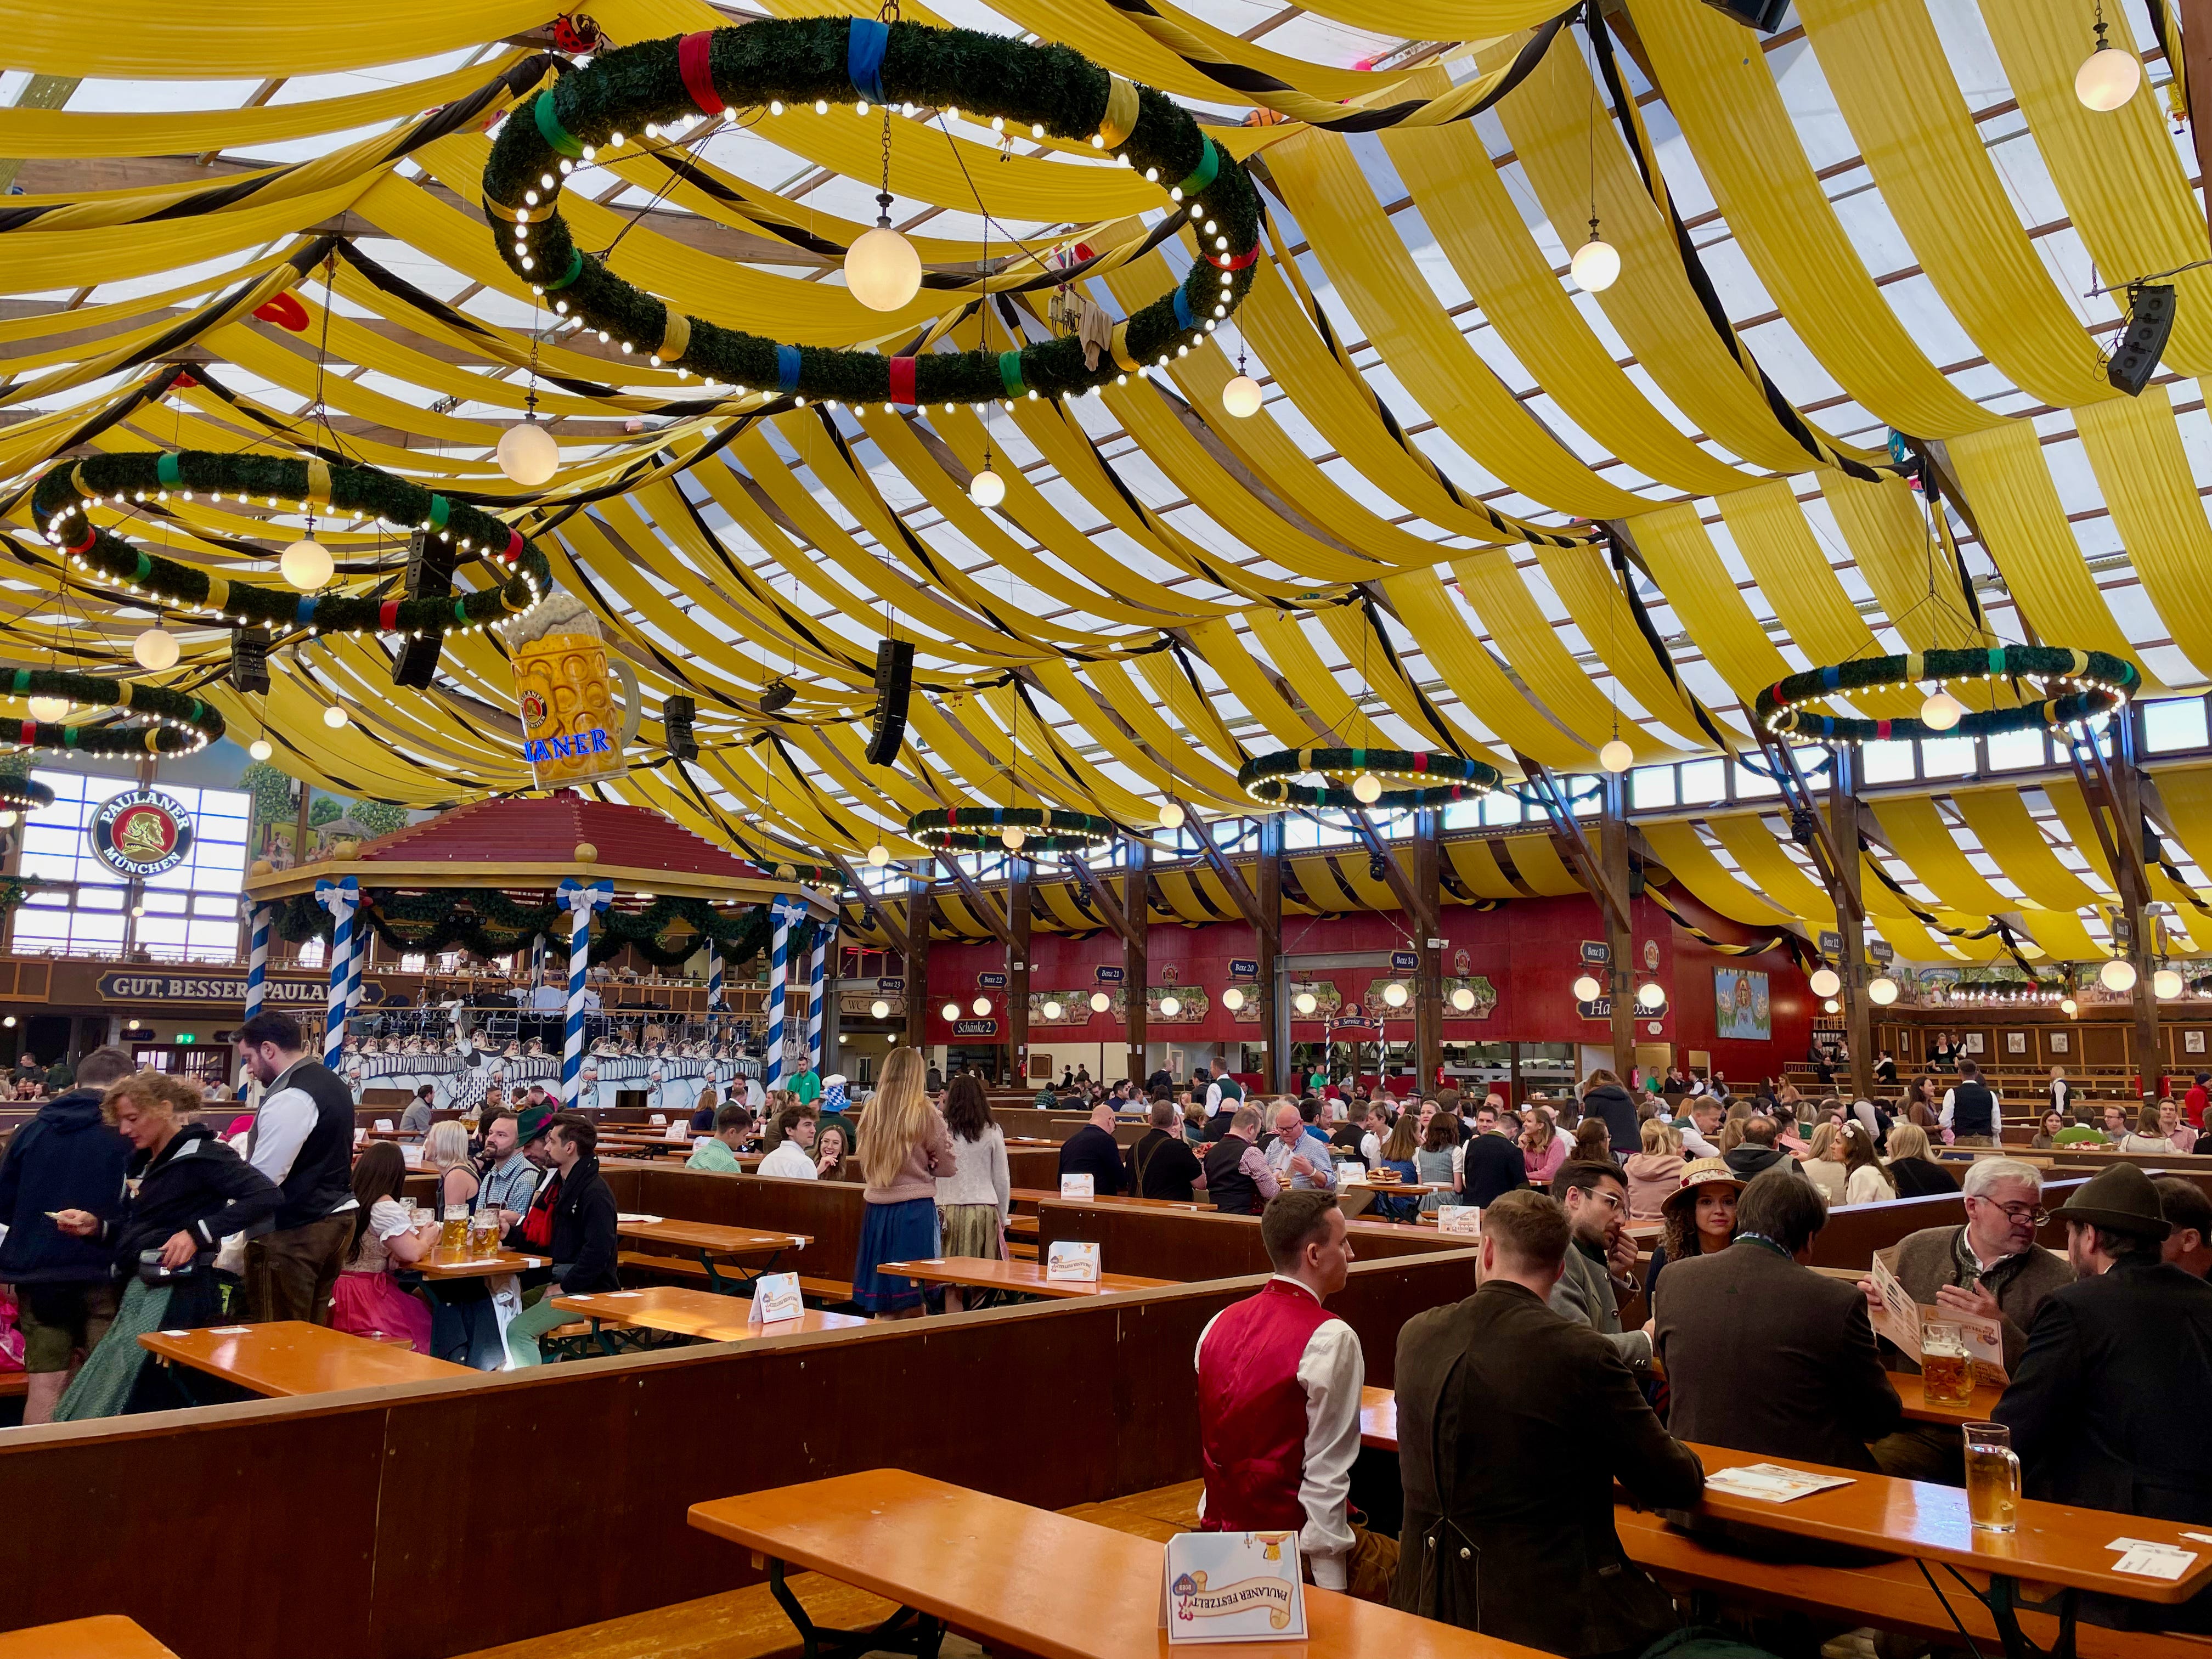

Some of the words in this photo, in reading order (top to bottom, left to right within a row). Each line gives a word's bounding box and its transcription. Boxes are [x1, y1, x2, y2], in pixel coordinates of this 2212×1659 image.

[100, 791, 190, 831] PAULANER
[103, 845, 181, 874] MÜNCHEN
[1834, 939, 1839, 948] 12
[1588, 946, 1599, 956] Boxe
[1599, 948, 1604, 959] 13
[1235, 963, 1247, 972] Boxe
[1246, 964, 1254, 972] 20
[1396, 956, 1408, 965] Boxe
[1408, 956, 1414, 967] 14
[112, 977, 163, 998] GUT,
[263, 980, 372, 1002] PAULAR.
[1590, 1001, 1655, 1015] Haoxe
[958, 1021, 985, 1033] Schänke
[985, 1022, 991, 1032] 2
[1192, 1593, 1239, 1609] FESTZELT
[1240, 1587, 1288, 1601] PAULANER
